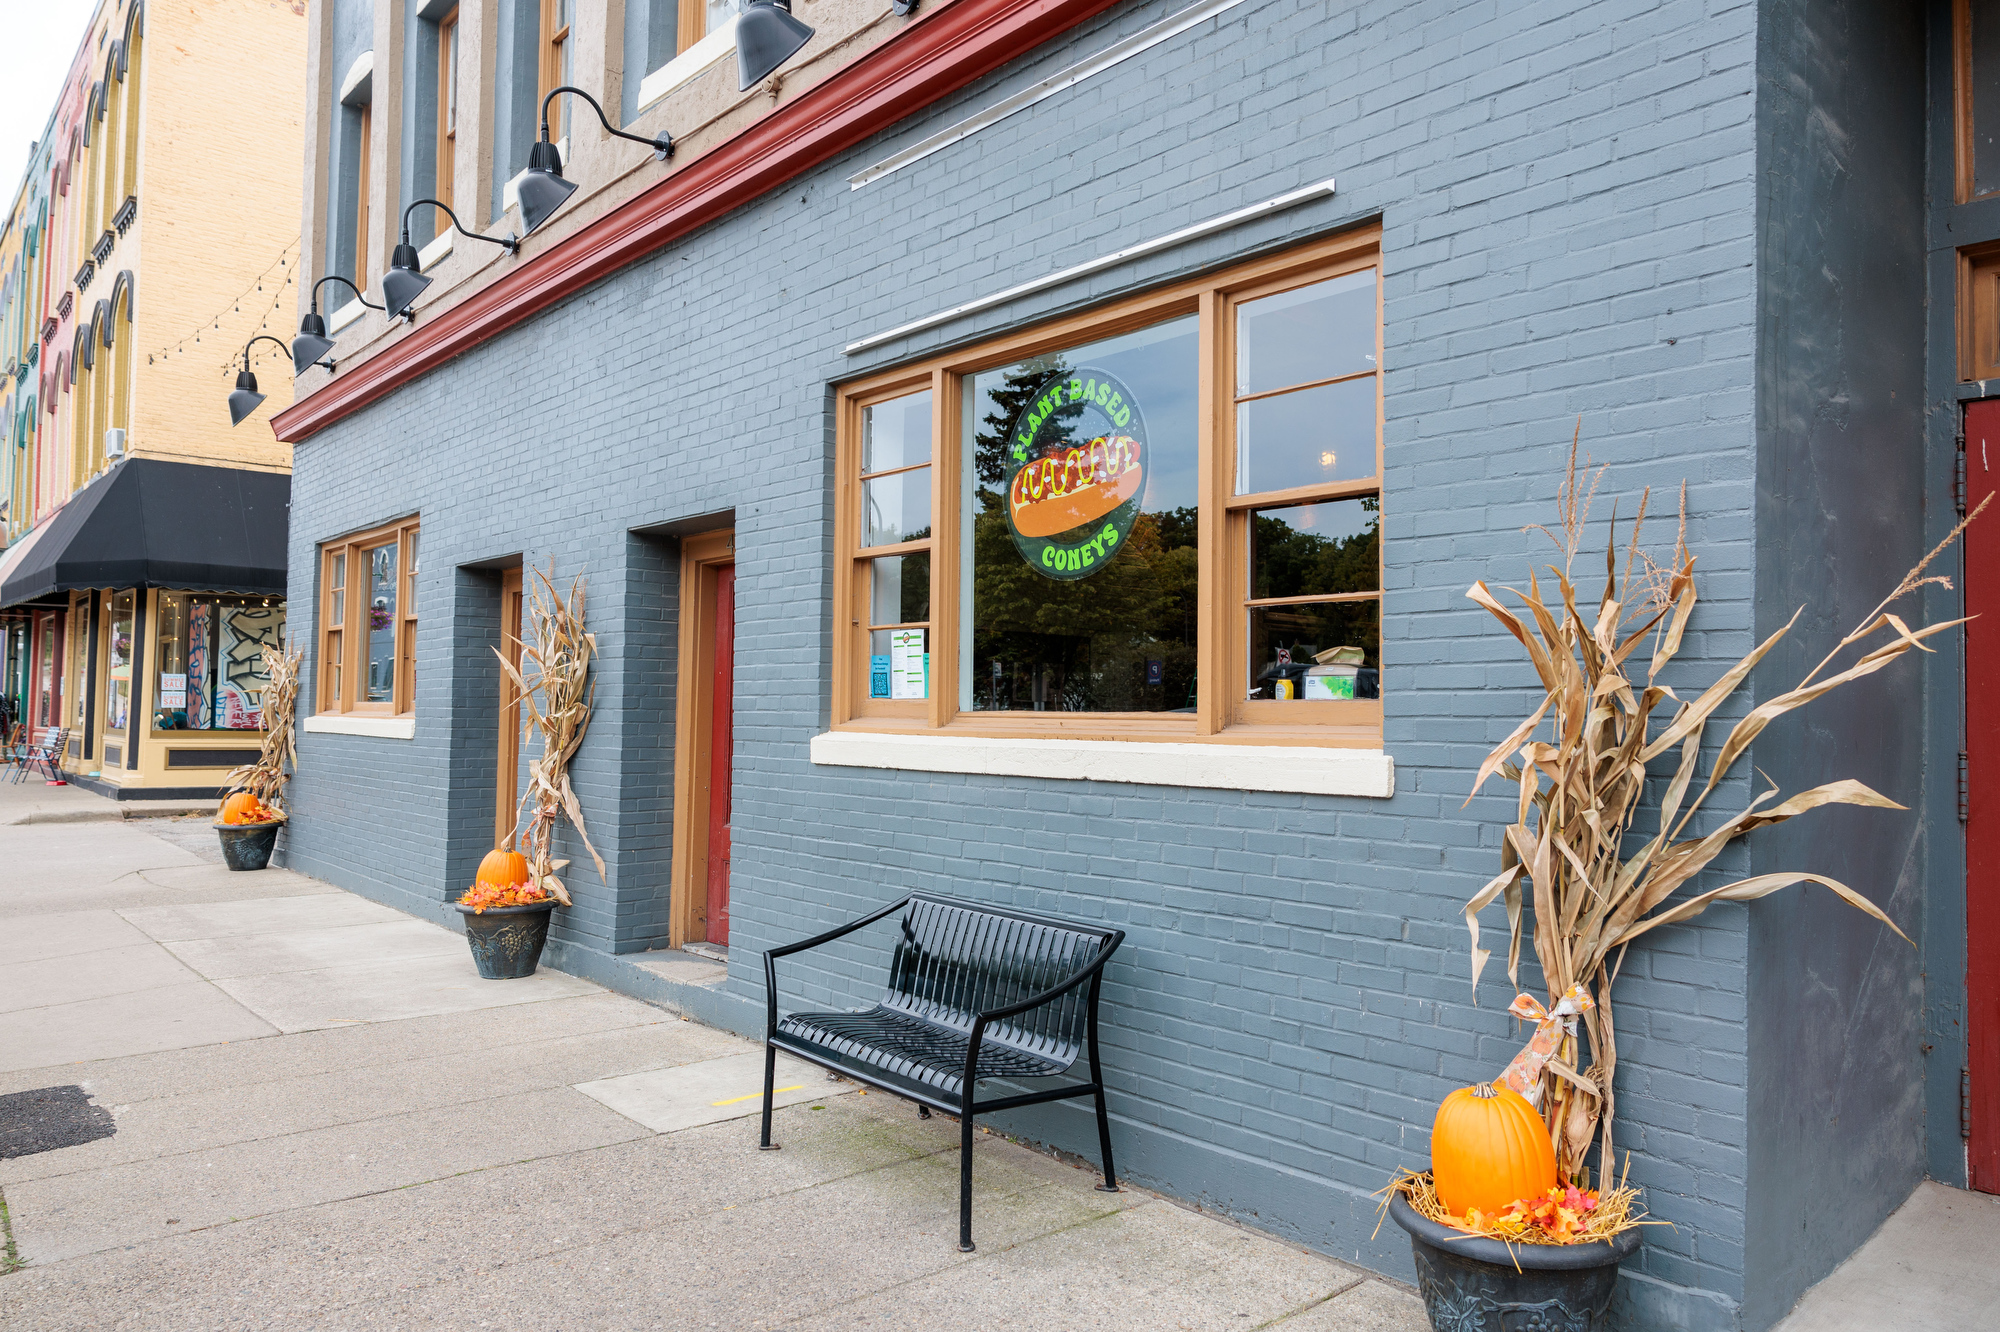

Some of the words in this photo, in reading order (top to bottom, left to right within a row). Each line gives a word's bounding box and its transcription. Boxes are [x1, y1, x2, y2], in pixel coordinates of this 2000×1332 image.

[1013, 385, 1063, 463] PLANT
[1069, 378, 1131, 428] BASED
[1042, 523, 1119, 571] CONEYS
